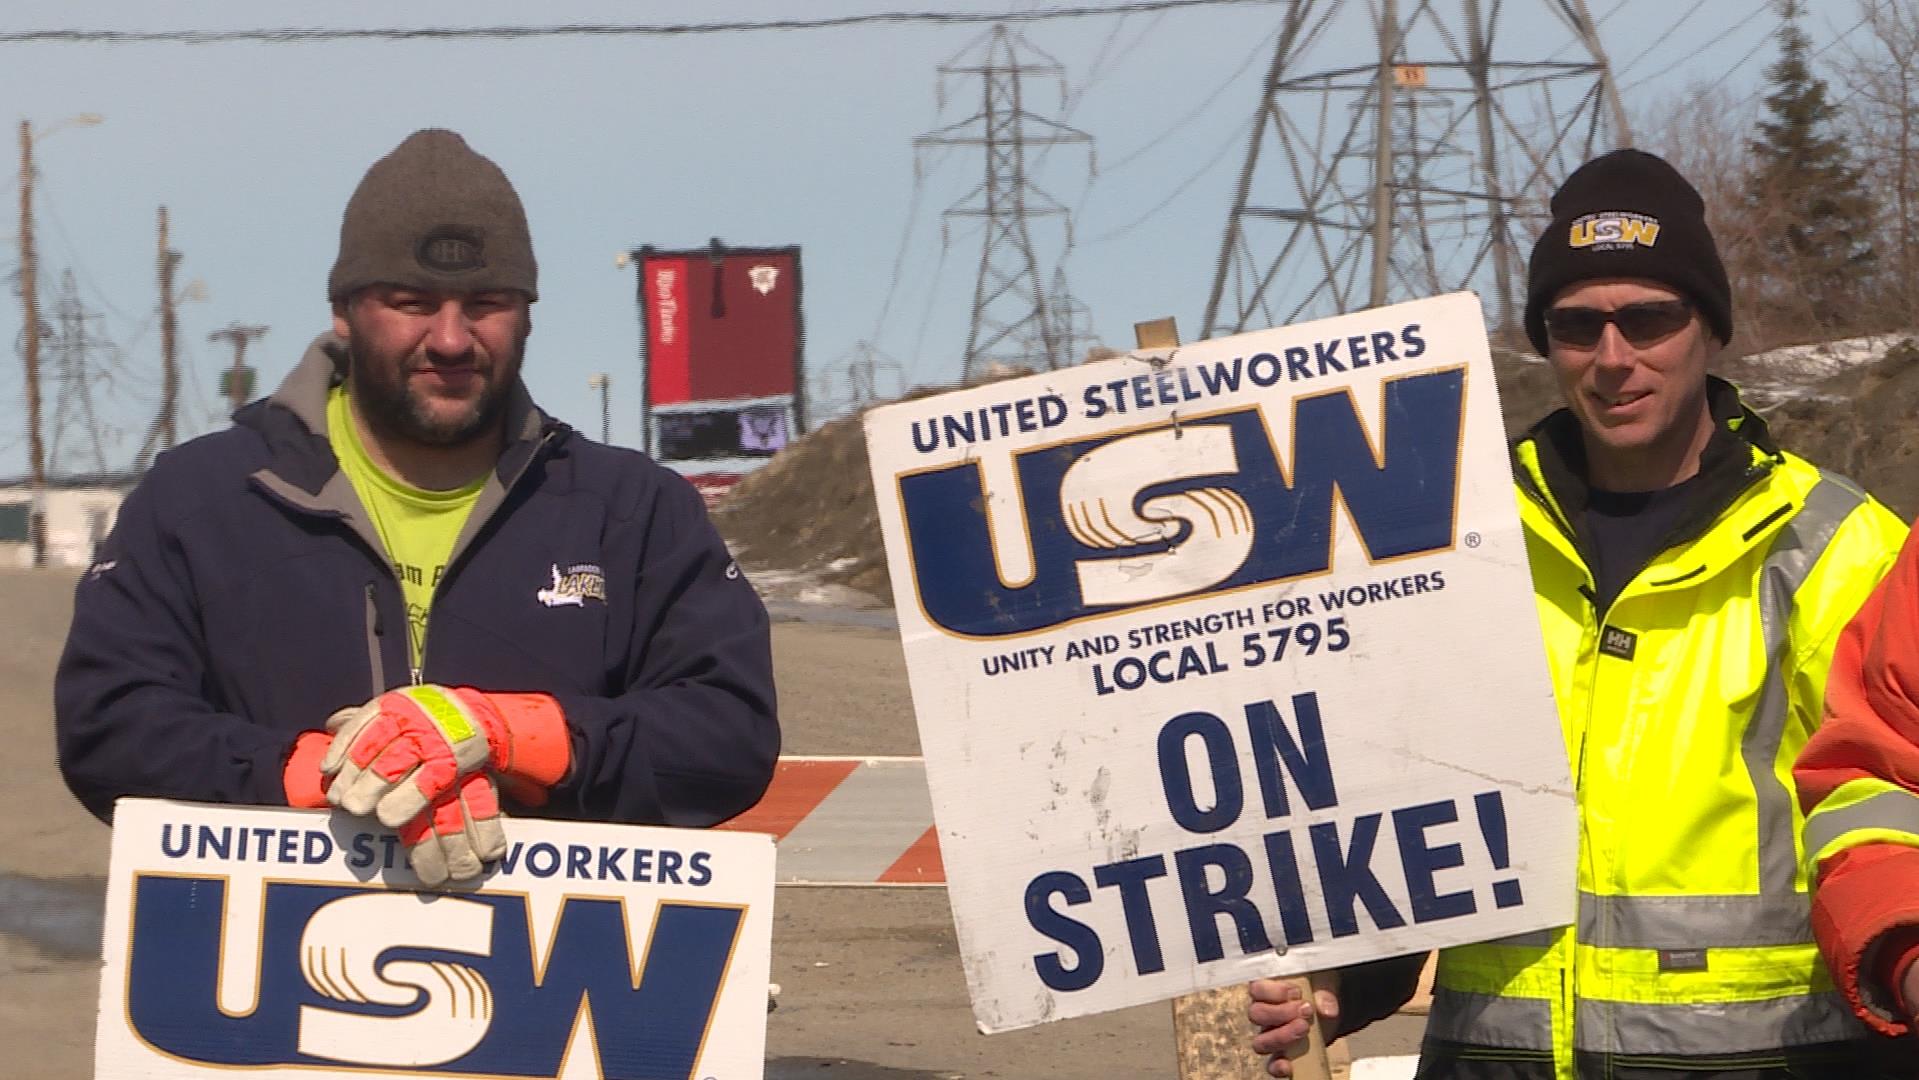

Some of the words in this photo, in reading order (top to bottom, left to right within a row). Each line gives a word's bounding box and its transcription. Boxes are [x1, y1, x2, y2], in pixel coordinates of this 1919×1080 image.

[1569, 217, 1660, 247] USW
[912, 394, 1068, 453] UNITED
[1085, 325, 1426, 419] STEELWORKERS
[895, 363, 1469, 640] USW
[983, 647, 1054, 676] UNITY
[1066, 635, 1118, 662] AND
[1128, 609, 1254, 650] STRENGTH
[1263, 598, 1314, 624] FOR
[1319, 571, 1445, 612] WORKERS
[1093, 643, 1228, 696] LOCAL
[1244, 618, 1350, 668] 5795
[1157, 691, 1338, 834] ON
[162, 824, 334, 866] UNITED
[351, 833, 712, 886] STWORKERS
[1024, 790, 1523, 993] STRIKE!
[125, 870, 749, 1080] USW
